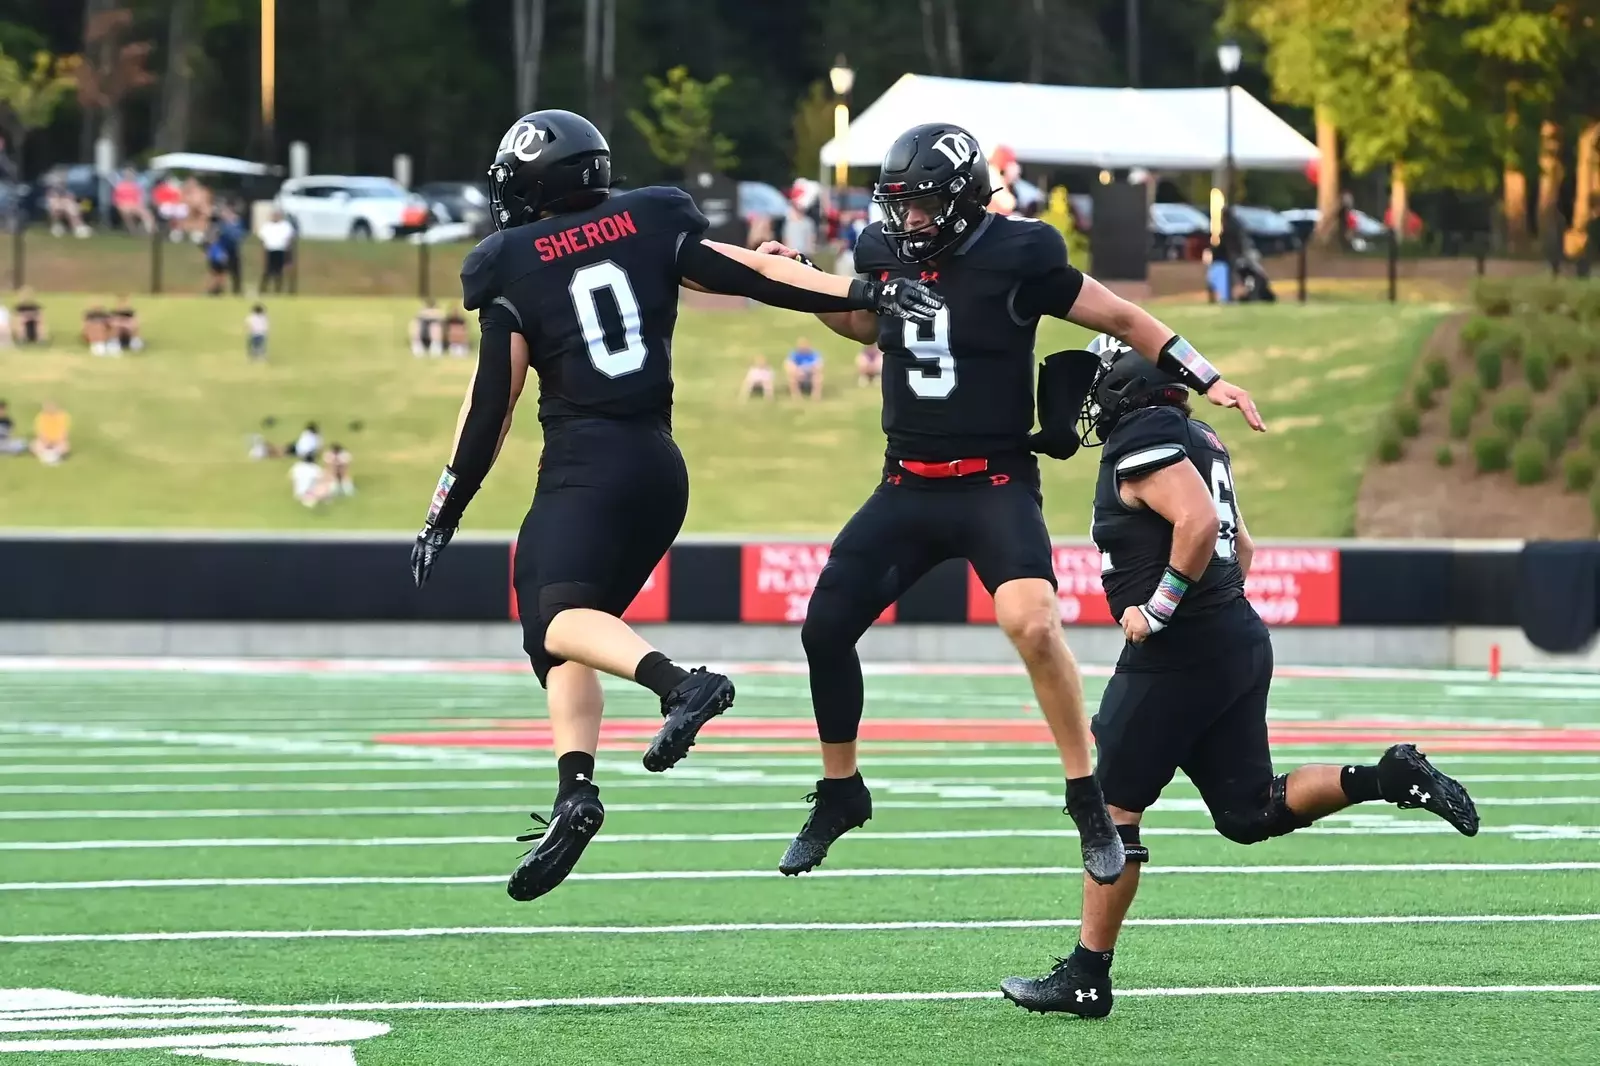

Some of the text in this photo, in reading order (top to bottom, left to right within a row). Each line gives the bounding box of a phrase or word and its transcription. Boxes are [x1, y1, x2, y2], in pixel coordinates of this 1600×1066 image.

[534, 210, 638, 263] SHERON
[567, 258, 650, 380] 0
[901, 302, 959, 400] 9
[1209, 458, 1237, 560] 6
